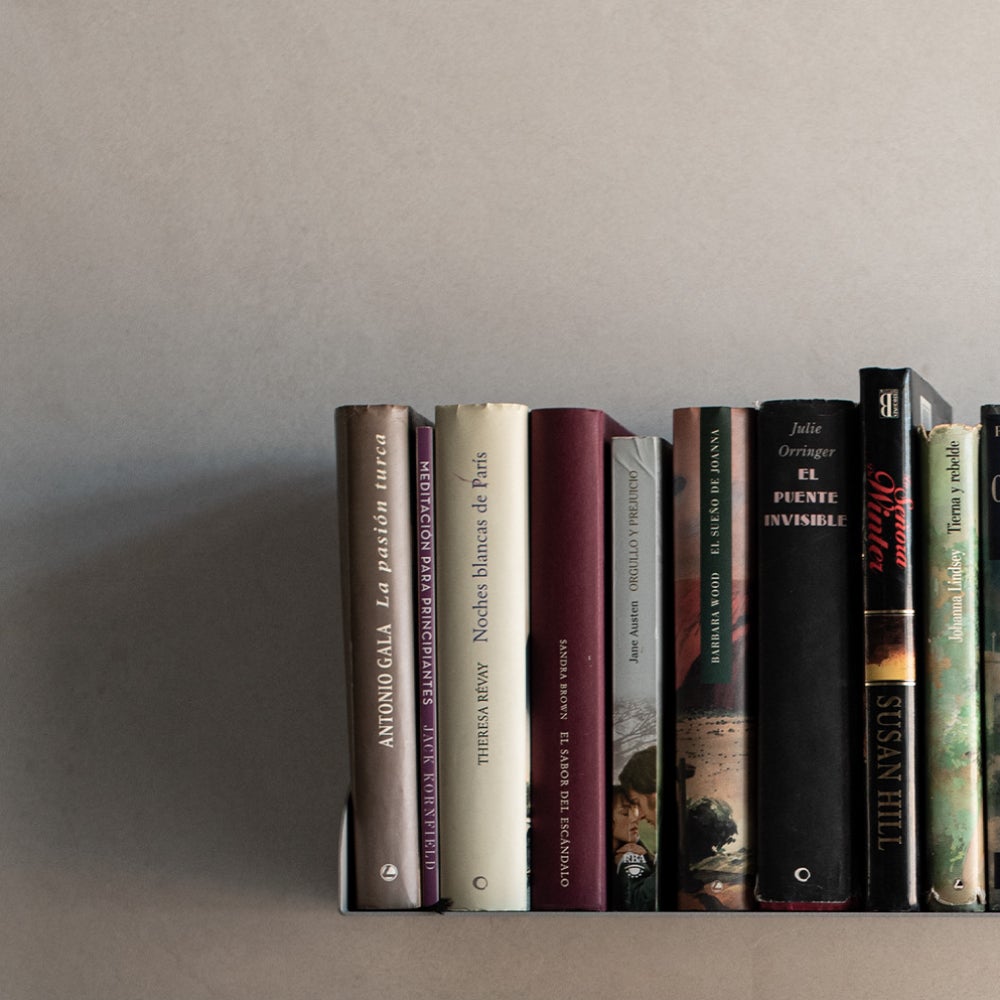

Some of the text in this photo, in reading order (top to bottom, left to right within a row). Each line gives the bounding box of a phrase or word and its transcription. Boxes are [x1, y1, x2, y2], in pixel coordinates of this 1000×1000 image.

[779, 444, 837, 458] Orringer
[789, 422, 822, 435] Julie
[709, 429, 720, 663] BARBARA WOOD SUEÑO JOANNA
[764, 514, 848, 527] INVISIBLE
[773, 491, 839, 504] PUENTE
[867, 471, 895, 572] Winter
[947, 440, 967, 591] Lindsey Tierna rebelde
[371, 433, 394, 748] ANTONIO GALA pasión turca
[419, 460, 433, 705] MEDITACIÓN PARA PRINCIPIANTES
[472, 452, 489, 765] THERESA RÉVAY Noches blancas París
[628, 470, 641, 664] Jane Austen ORGULLO PREJUICIO
[560, 639, 568, 679] SANDRA
[422, 724, 435, 870] JACK KORNFIELD
[560, 749, 569, 787] SABOR
[877, 695, 902, 851] SUSAN HILL
[560, 816, 571, 887] ESCÁNDALO
